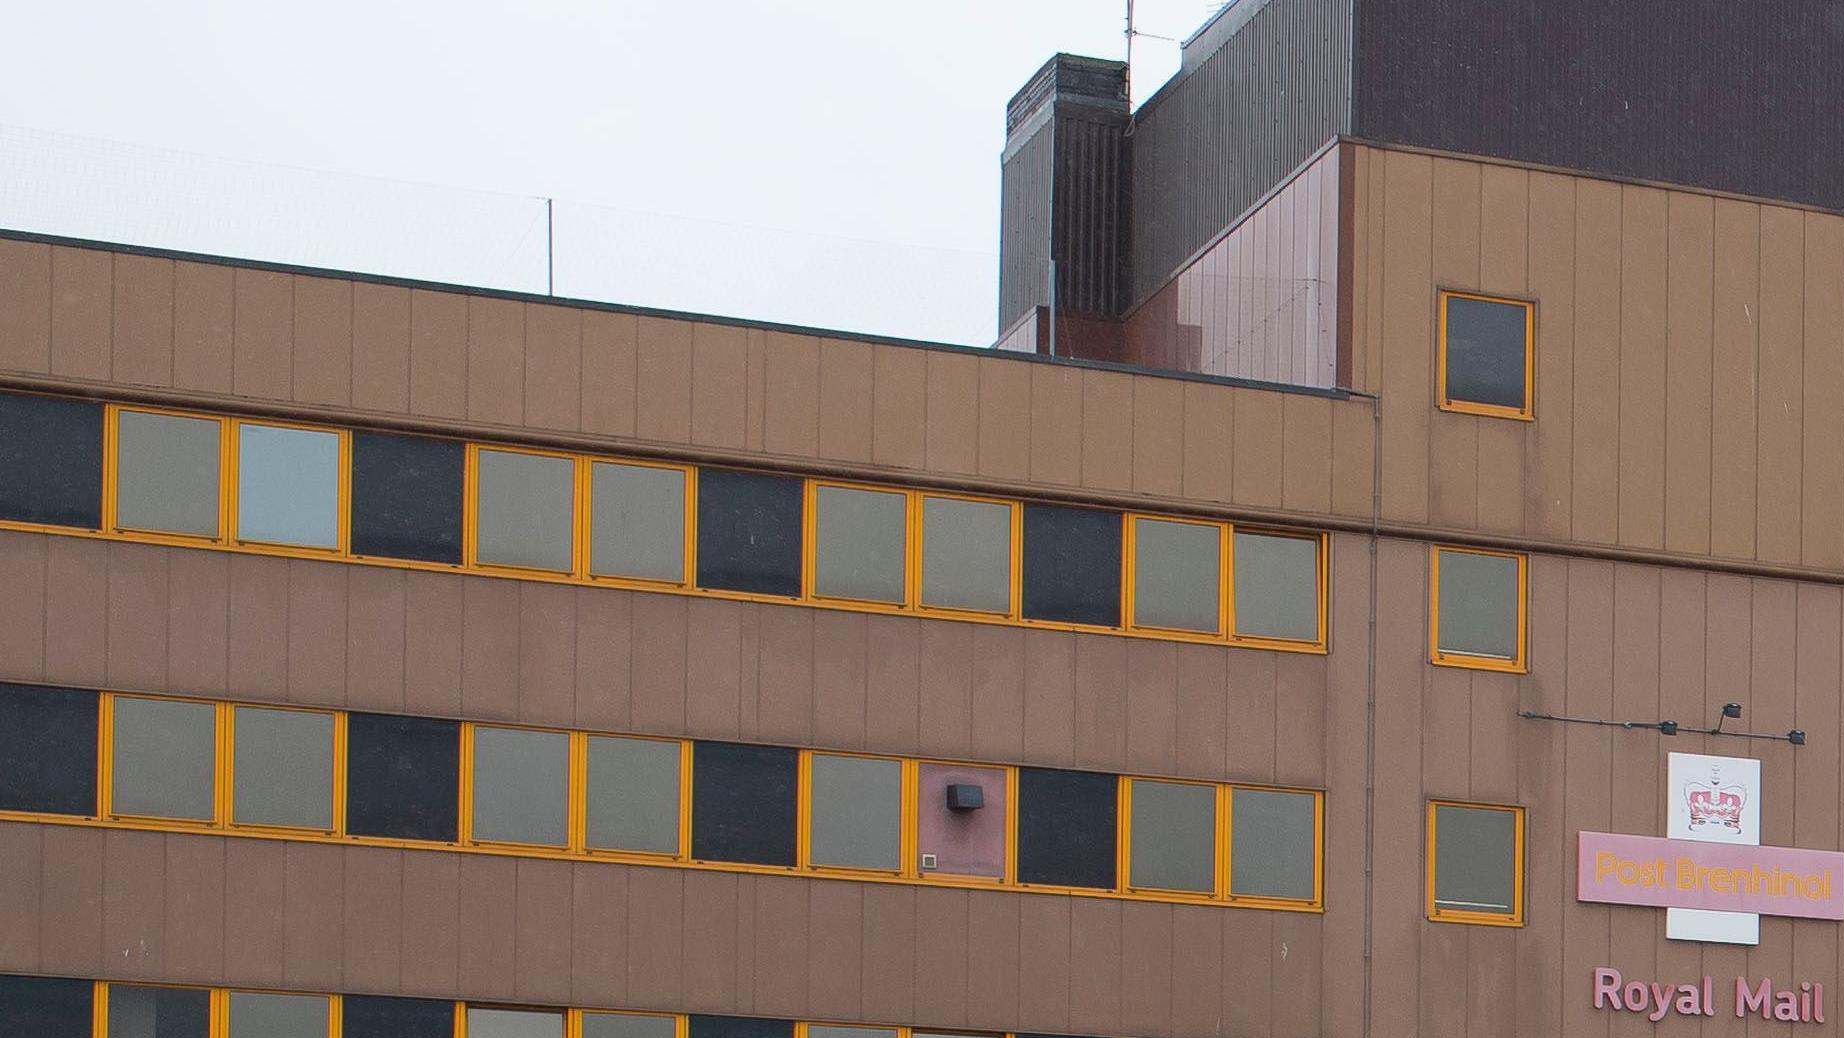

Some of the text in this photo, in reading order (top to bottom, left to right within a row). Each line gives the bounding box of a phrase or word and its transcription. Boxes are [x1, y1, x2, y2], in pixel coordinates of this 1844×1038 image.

[1595, 851, 1832, 900] Post Brenhinol
[1593, 967, 1825, 1024] Royal Mail
